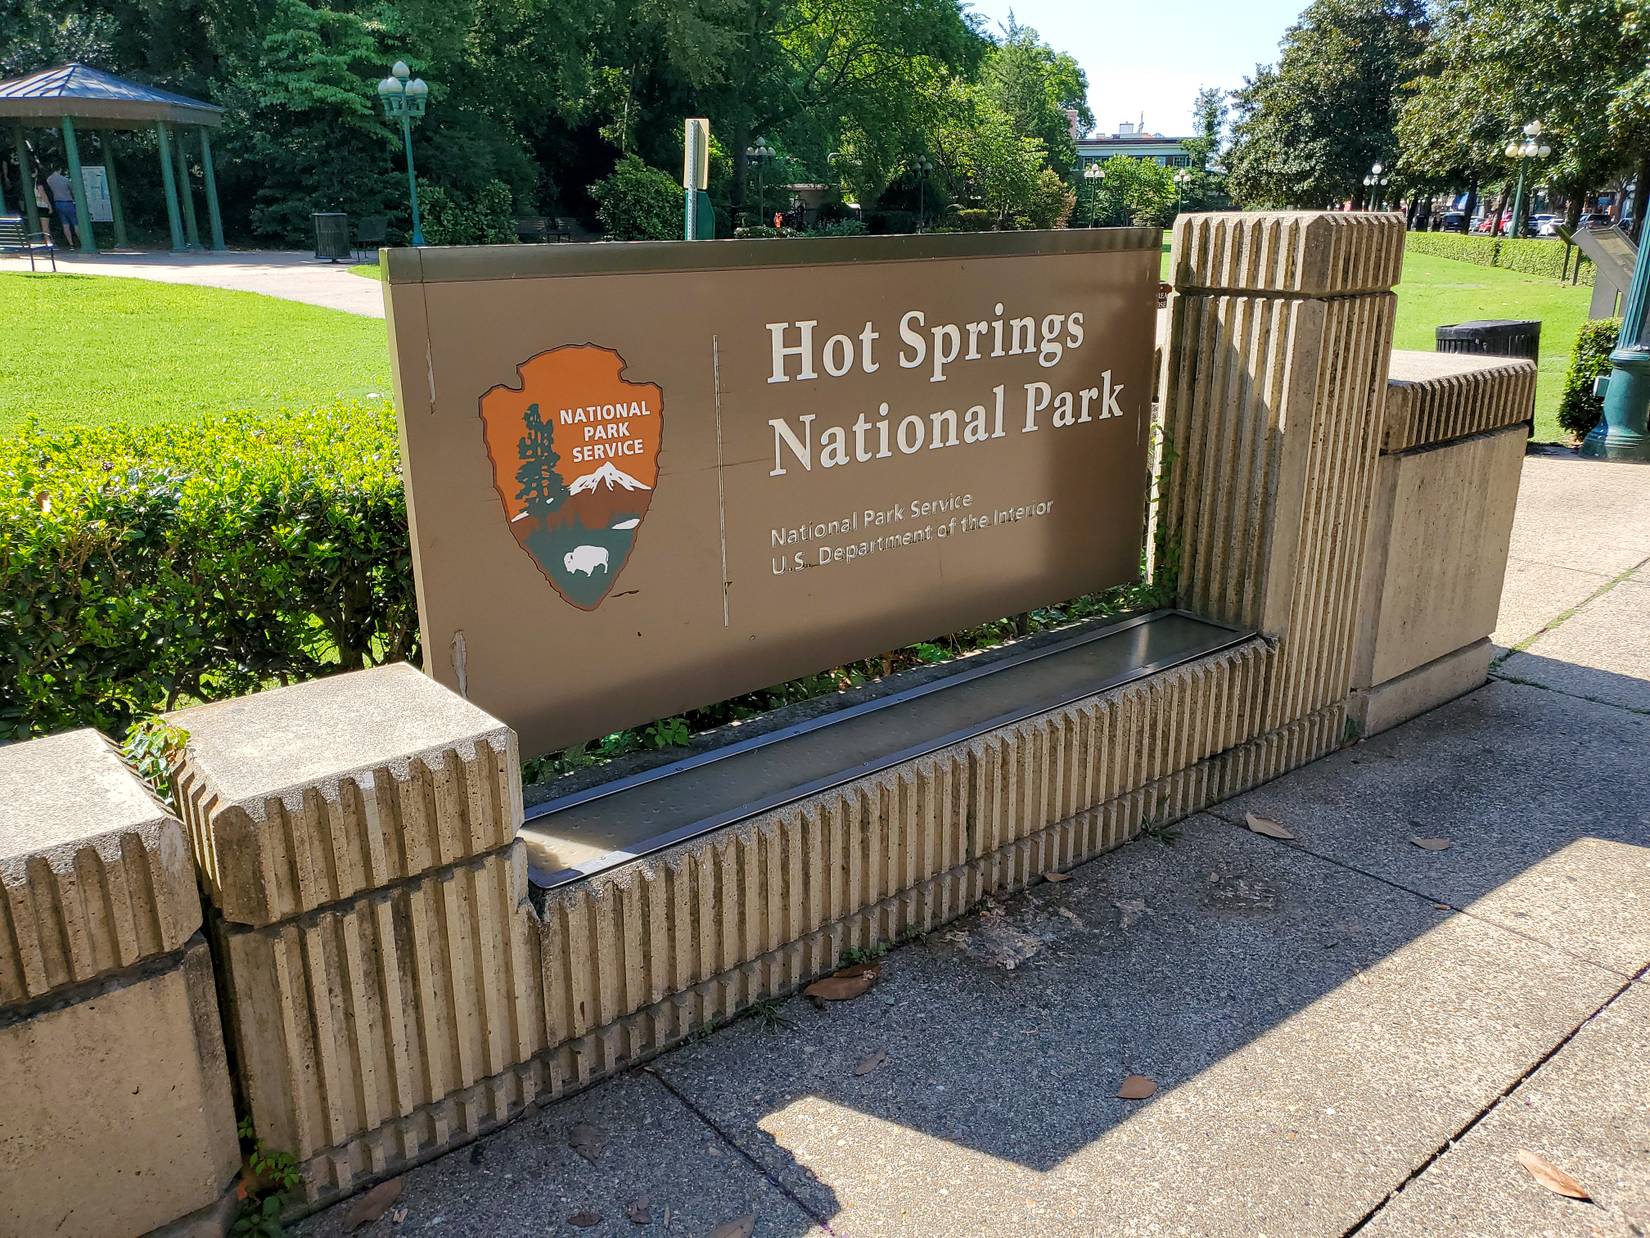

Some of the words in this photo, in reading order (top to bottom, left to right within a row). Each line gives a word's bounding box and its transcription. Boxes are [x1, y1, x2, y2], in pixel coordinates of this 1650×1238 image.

[766, 319, 880, 383] Hot
[899, 303, 1084, 382] Springs
[559, 400, 650, 425] NATIONAL
[584, 422, 630, 441] PARK
[768, 384, 1006, 477] National
[1022, 369, 1125, 433] Park
[572, 439, 643, 463] SERVICE
[771, 517, 857, 548] National
[864, 503, 904, 528] Park
[910, 493, 973, 518] Service
[772, 552, 810, 575] U.S.
[819, 523, 933, 565] Department
[937, 517, 956, 538] of
[961, 512, 989, 532] the
[994, 499, 1054, 525] Interior
